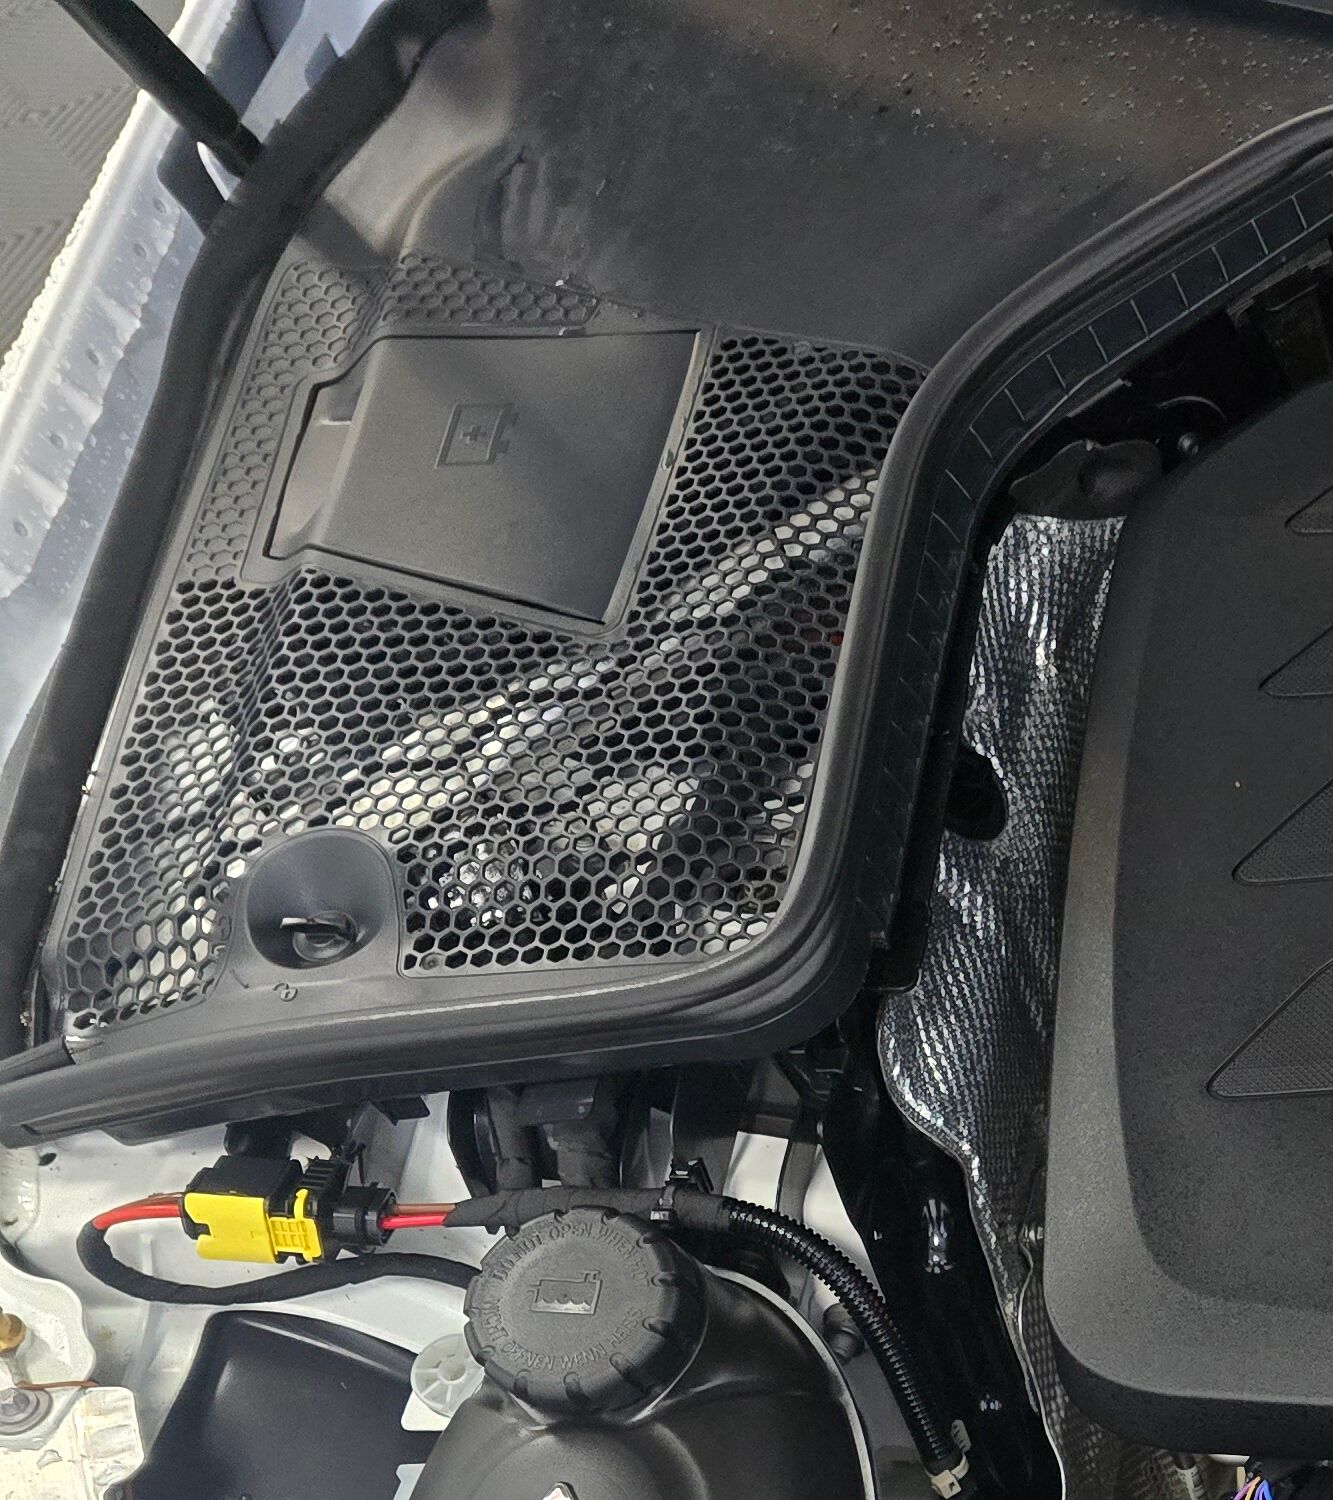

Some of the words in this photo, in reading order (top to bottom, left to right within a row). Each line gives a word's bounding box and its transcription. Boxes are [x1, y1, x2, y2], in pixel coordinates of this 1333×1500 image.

[513, 1232, 542, 1261] NOT
[550, 1222, 593, 1241] OPEN
[598, 1225, 636, 1260] WHEN
[560, 1342, 608, 1370] WENN
